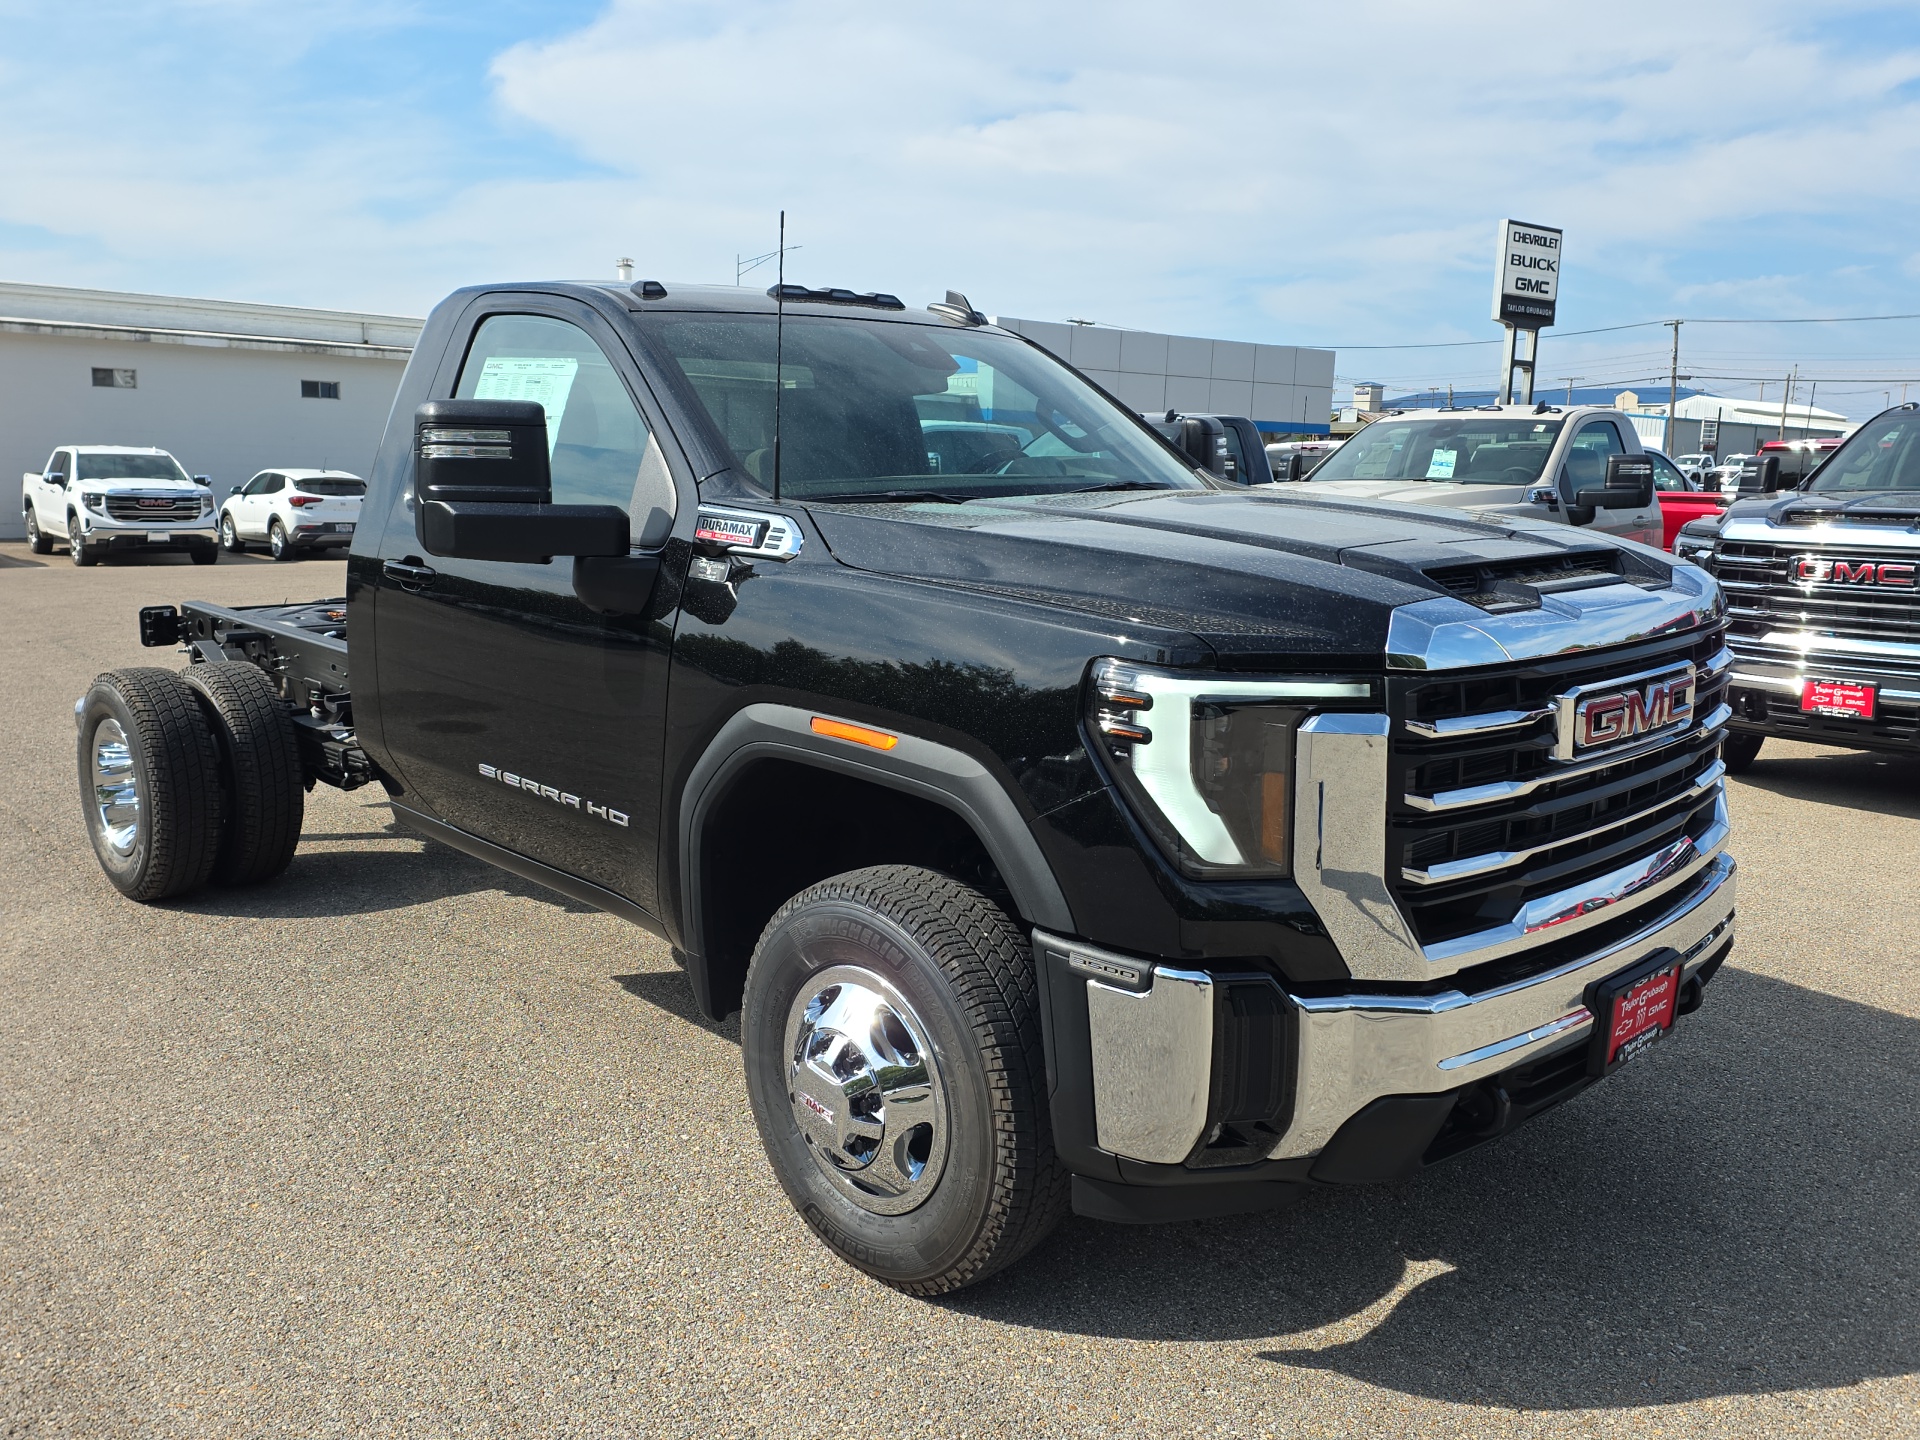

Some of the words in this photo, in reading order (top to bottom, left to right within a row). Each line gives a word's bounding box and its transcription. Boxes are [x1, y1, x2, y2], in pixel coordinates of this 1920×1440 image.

[1513, 231, 1559, 249] CHEVROLET
[1511, 254, 1556, 272] BUICK
[1515, 277, 1550, 294] GMC
[1507, 303, 1525, 312] TAYLOR
[138, 499, 173, 507] GMC
[702, 519, 753, 535] DURAMAX
[1797, 560, 1915, 585] GMC
[1576, 673, 1694, 748] GMC
[478, 763, 581, 809] SIERRA
[586, 801, 631, 827] HD
[817, 918, 905, 966] MICHELIN
[1621, 997, 1640, 1018] Taylor
[1639, 980, 1669, 1006] Grubaugh
[1648, 999, 1668, 1017] GMC
[805, 1204, 894, 1268] MICHELIN
